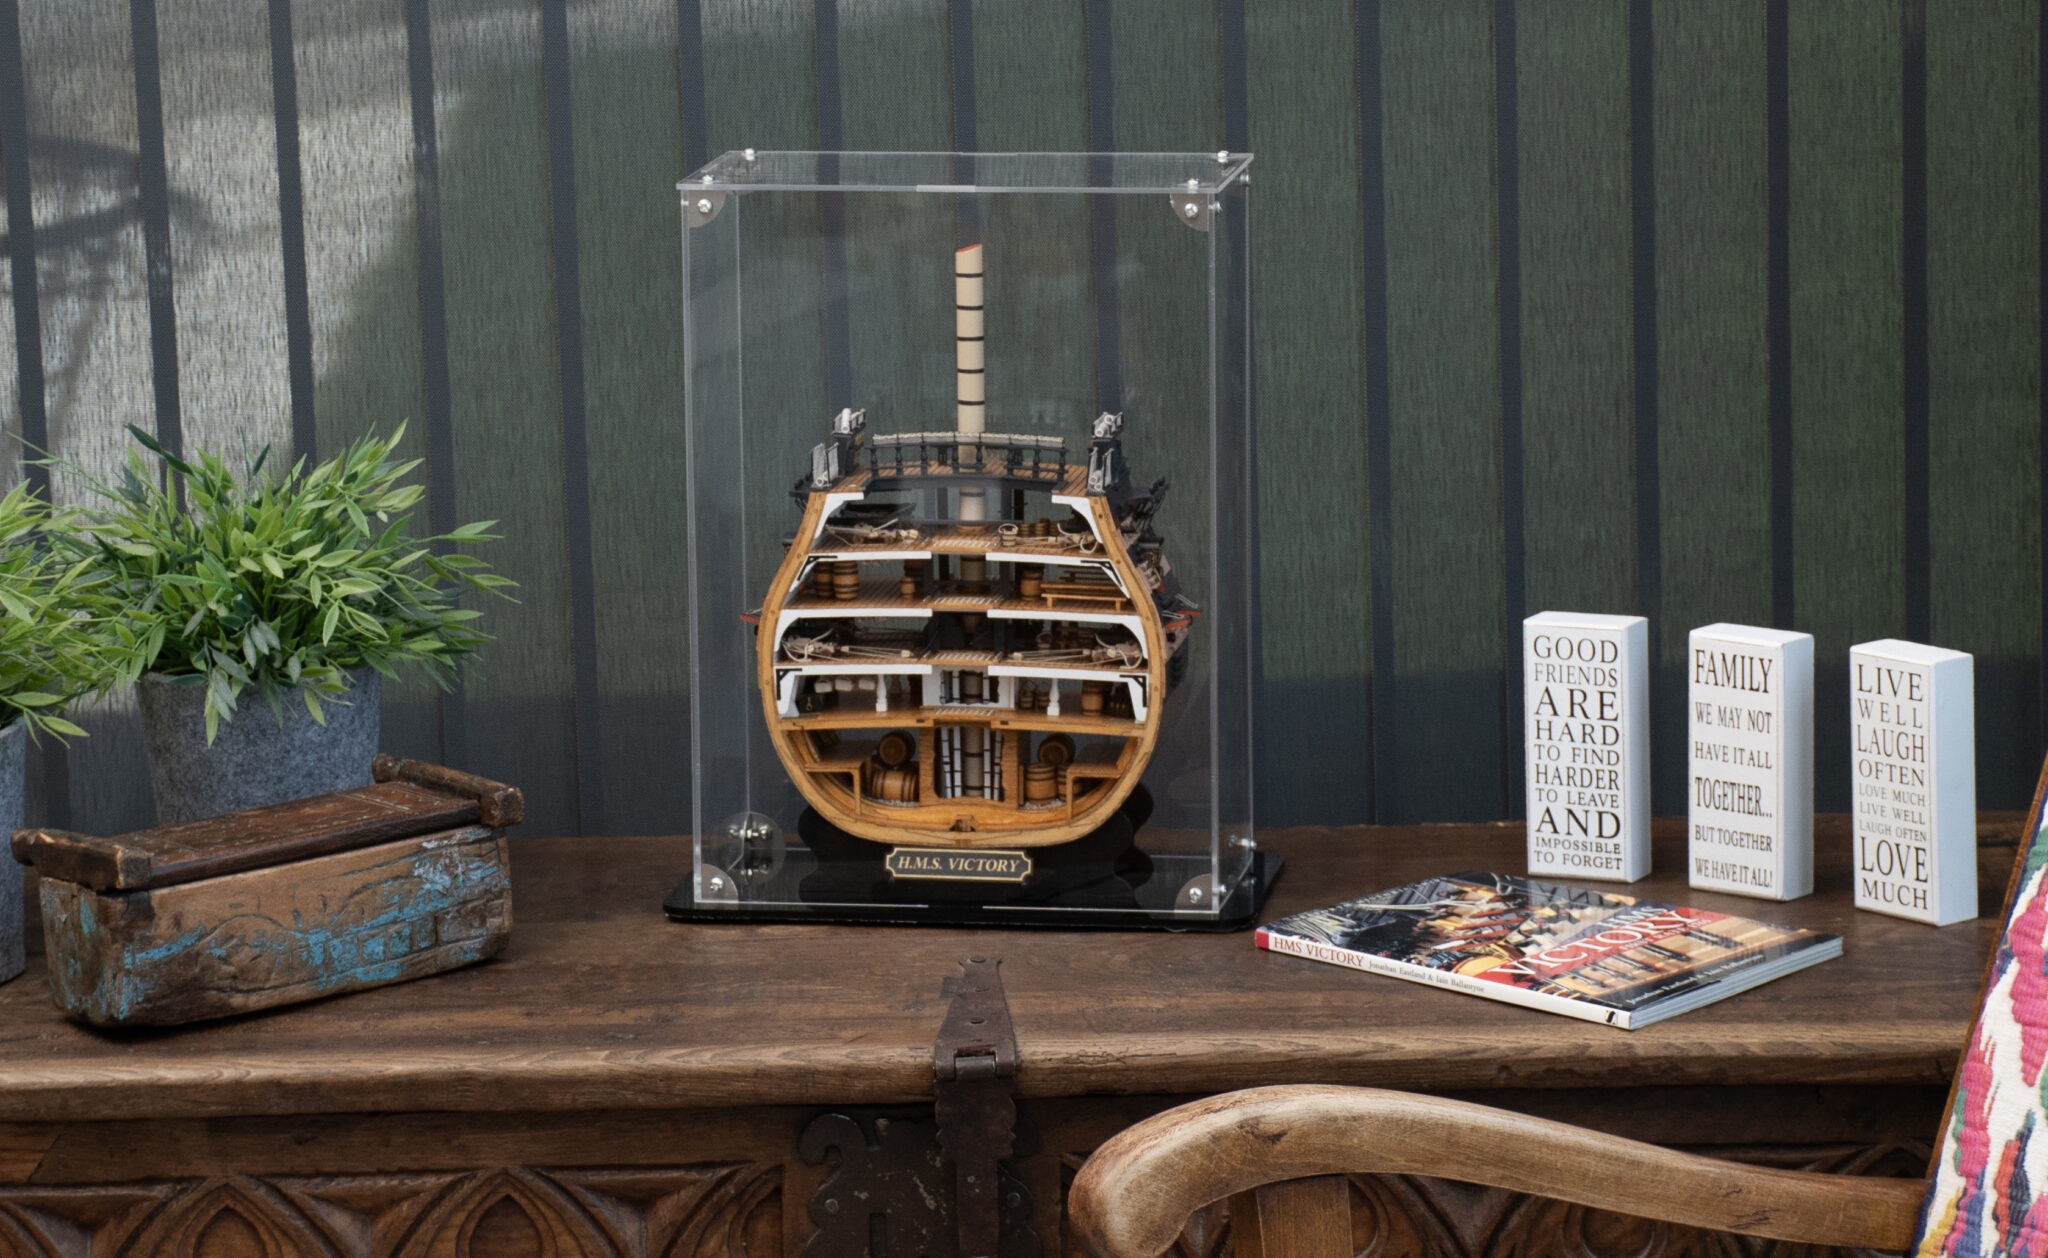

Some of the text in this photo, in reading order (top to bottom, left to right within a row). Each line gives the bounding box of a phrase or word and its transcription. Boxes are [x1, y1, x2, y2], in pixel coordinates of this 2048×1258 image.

[1533, 635, 1618, 664] GOOD
[1534, 663, 1618, 688] FRIENDS
[1694, 648, 1773, 694] FAMILY
[1857, 663, 1923, 702] LIVE
[1533, 686, 1619, 722] ARE
[1695, 702, 1772, 734] WE MAY NOT
[1857, 698, 1923, 729] WELL
[1535, 719, 1620, 746] HARD
[1856, 724, 1925, 763] LAUGH
[1534, 744, 1620, 767] TO FIND
[1695, 741, 1772, 769] HAVE IT ALL
[1535, 764, 1620, 791] HARDER
[1858, 758, 1925, 788] OFTEN
[1535, 788, 1619, 809] TO LEAVE
[1695, 776, 1773, 818] TOGETHER...
[1858, 782, 1926, 807] LOVE MUCH
[1536, 806, 1621, 839] AND
[1859, 801, 1926, 825] LIVE WELL
[1536, 836, 1621, 855] IMPOSSIBLE
[1695, 824, 1773, 852] BUT TOGETHER
[1859, 819, 1927, 843] LAUGH OFTEN
[897, 856, 1020, 873] H.M.S. VICTORY
[1534, 850, 1623, 870] TO FORGET
[1695, 857, 1773, 889] WE HAVE IT ALL!
[1859, 836, 1929, 884] LOVE
[1862, 877, 1929, 911] MUCH
[1597, 906, 1669, 931] HMS
[1273, 936, 1302, 954] HMS
[1306, 943, 1365, 967] VICTORY
[1369, 960, 1397, 973] Jonathan
[1487, 910, 1700, 975] VICTORY
